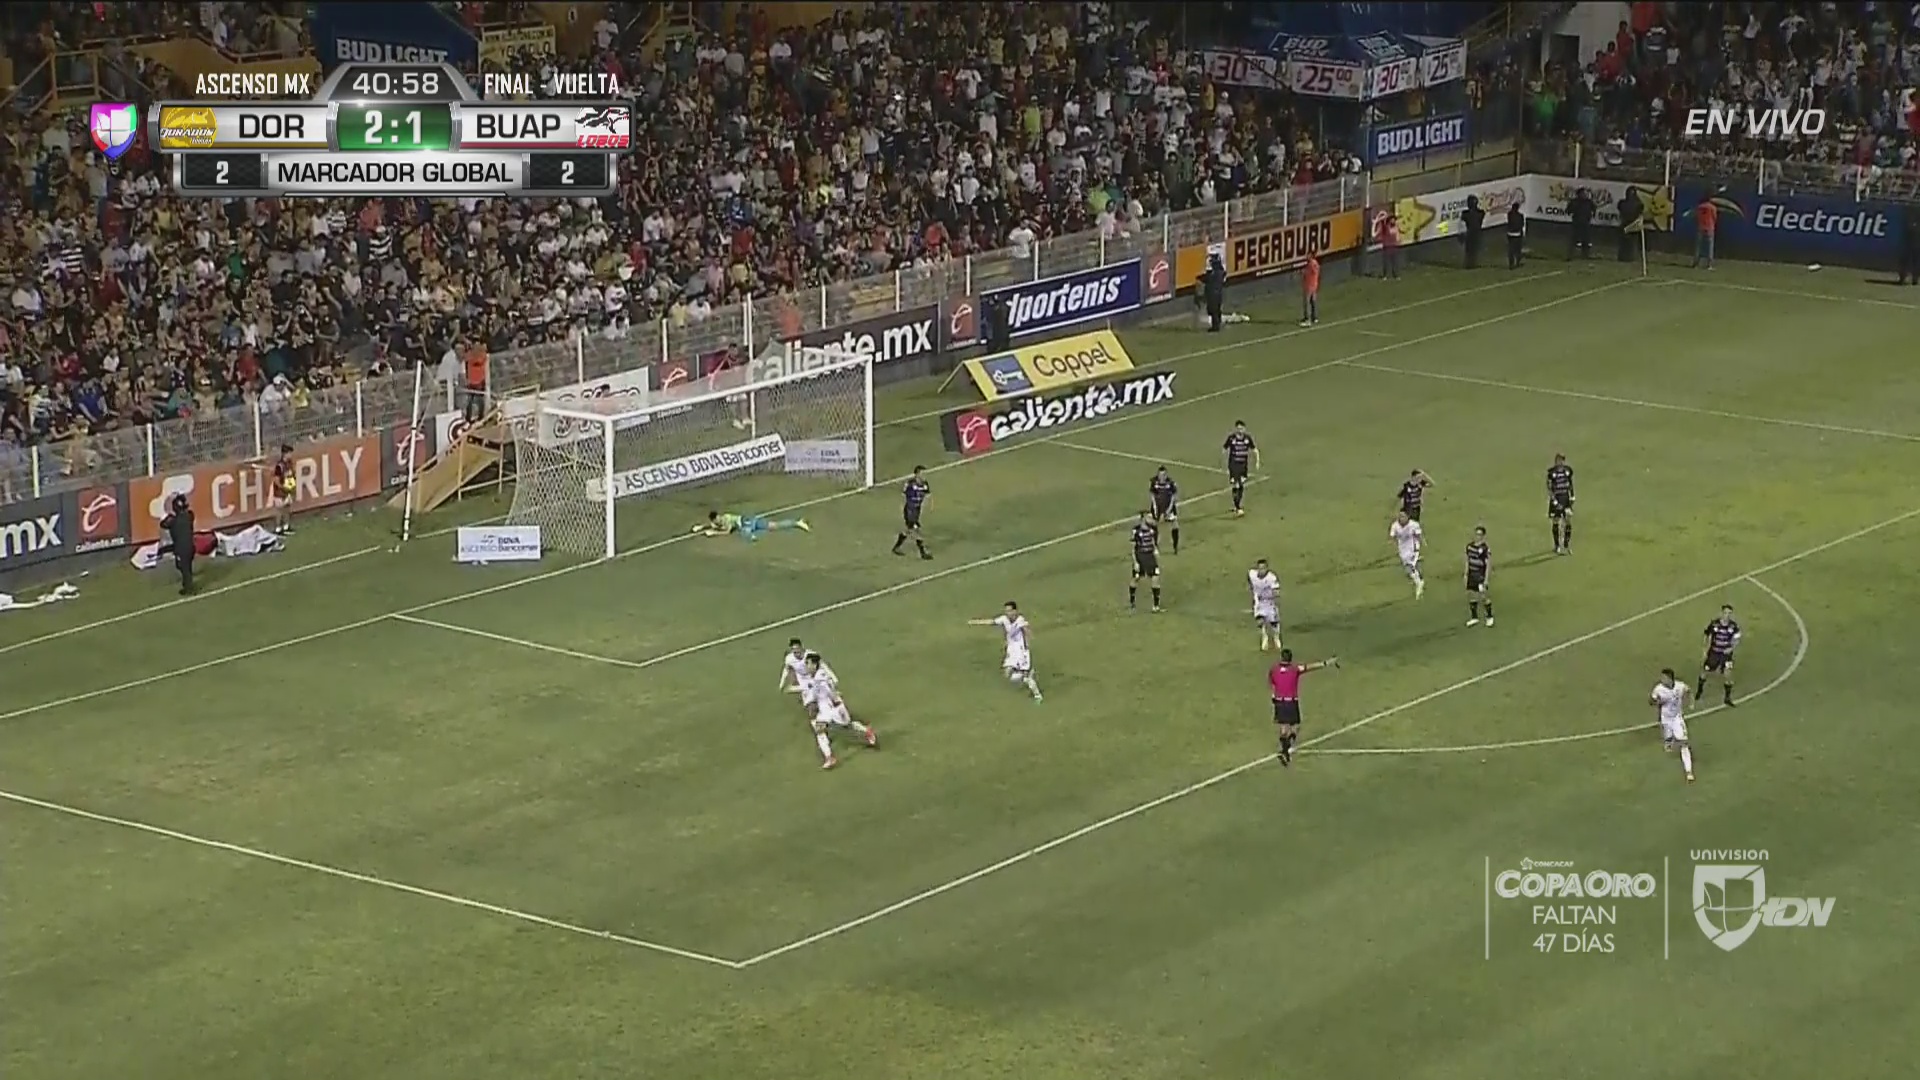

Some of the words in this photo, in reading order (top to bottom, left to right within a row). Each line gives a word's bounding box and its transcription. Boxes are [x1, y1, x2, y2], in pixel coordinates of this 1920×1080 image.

[336, 38, 382, 62] BUD
[385, 44, 449, 64] LIGHT
[1302, 65, 1334, 93] 25
[1377, 127, 1414, 155] BUD
[1415, 118, 1465, 148] LIGHT
[1755, 204, 1888, 237] Electrolit
[1234, 220, 1332, 272] PEGADURO
[1033, 341, 1116, 379] Coppel
[990, 371, 1178, 441] caliente.mx
[625, 463, 688, 490] ASCENSO
[723, 440, 781, 466] Bancomer
